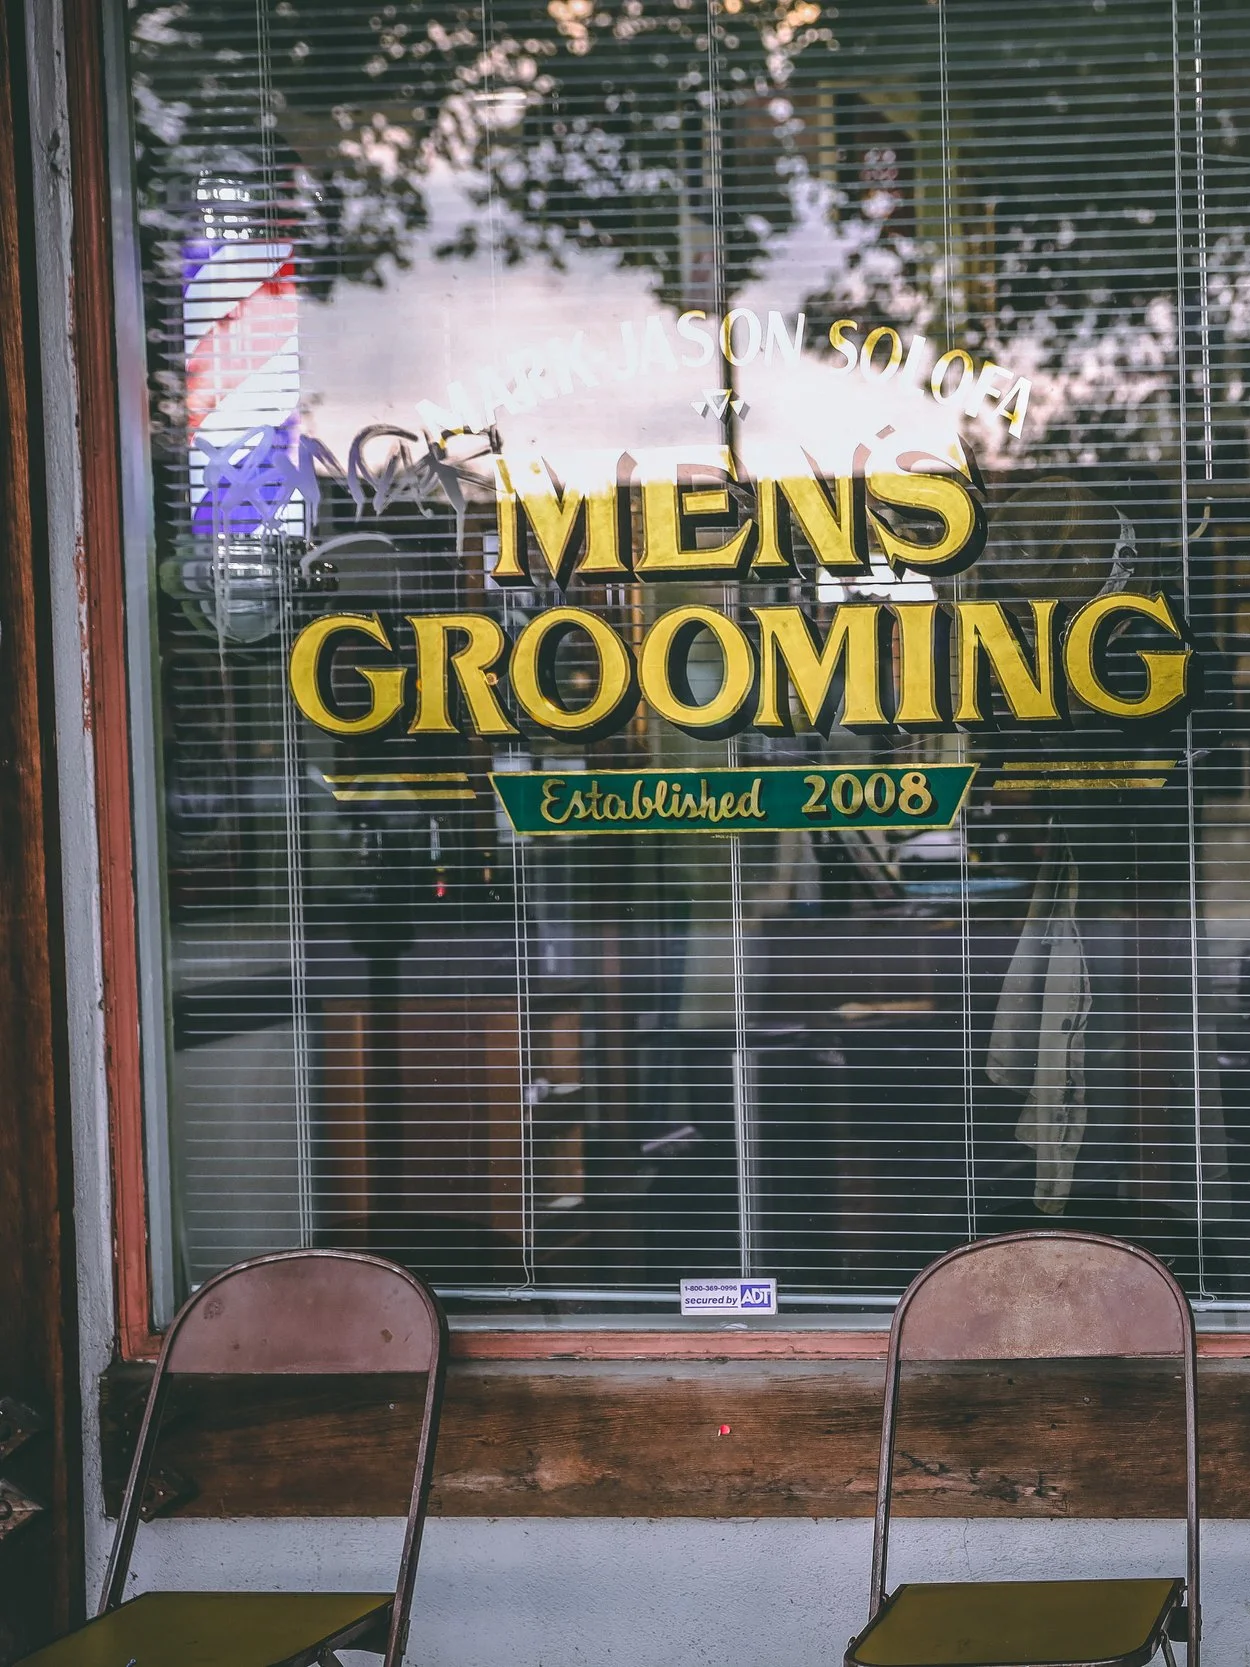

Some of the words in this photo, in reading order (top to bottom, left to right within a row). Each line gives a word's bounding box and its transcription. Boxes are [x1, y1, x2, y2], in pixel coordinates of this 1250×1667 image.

[828, 319, 1033, 441] SOLOFA
[289, 592, 1197, 738] GROOMING
[540, 778, 765, 823] Established
[801, 772, 933, 816] 2008
[685, 1296, 724, 1305] secured
[726, 1296, 738, 1305] by
[741, 1288, 771, 1304] ADT
